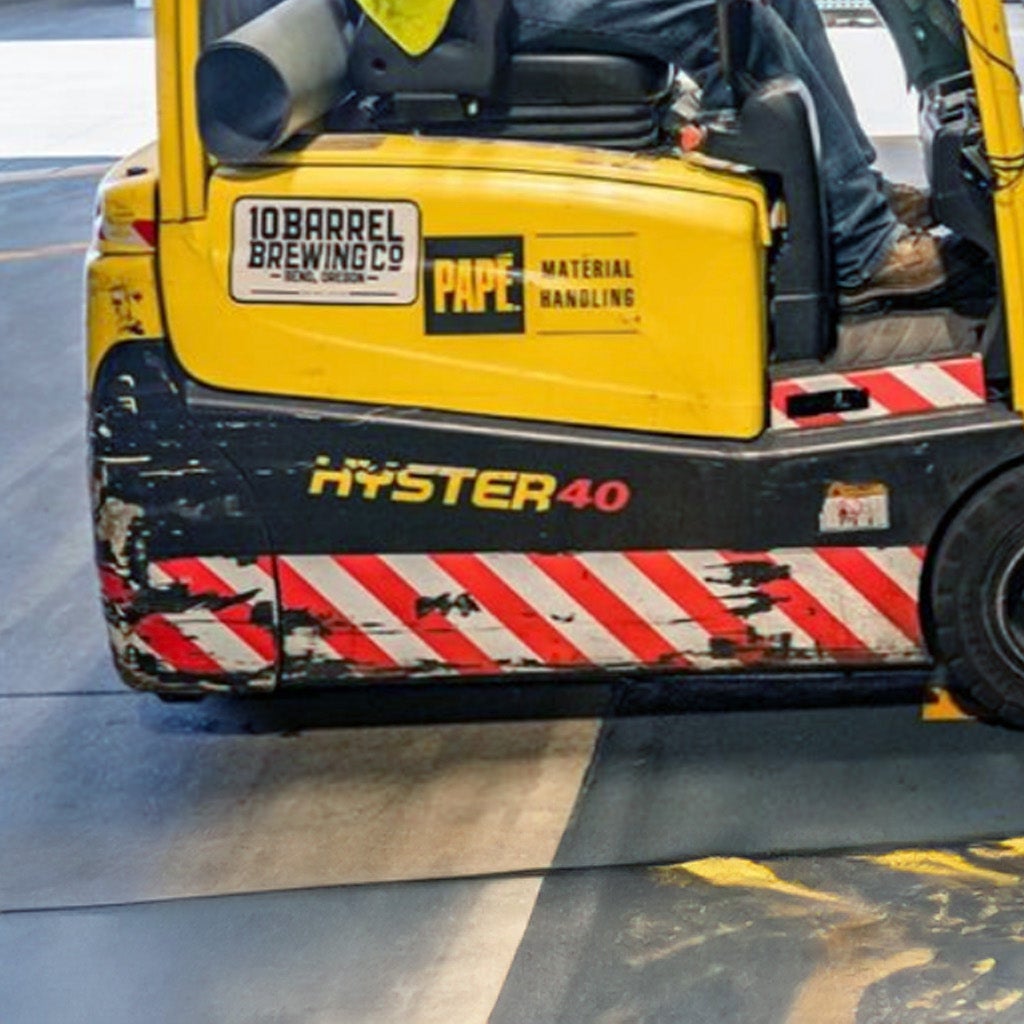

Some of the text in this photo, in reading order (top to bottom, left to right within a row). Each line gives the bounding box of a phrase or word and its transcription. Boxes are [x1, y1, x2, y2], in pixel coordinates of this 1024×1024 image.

[282, 207, 404, 242] BARREL
[248, 241, 368, 270] BREWING
[541, 258, 634, 280] MATERIAL
[540, 288, 635, 309] HANDLING
[308, 455, 557, 511] HYSTER
